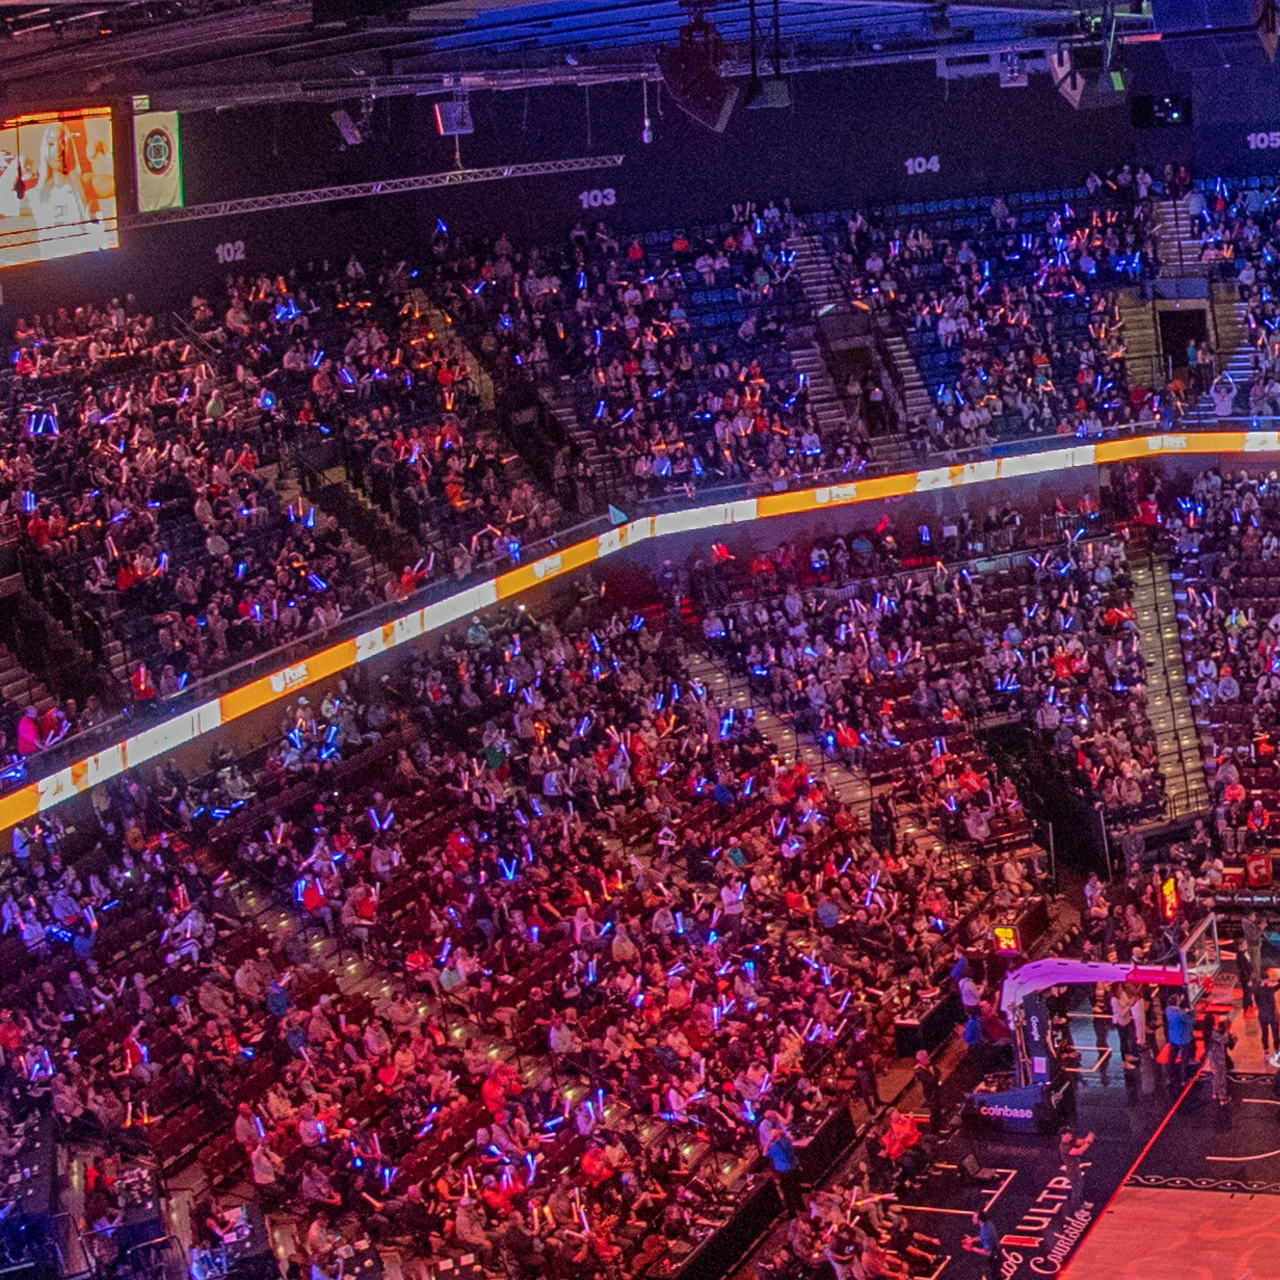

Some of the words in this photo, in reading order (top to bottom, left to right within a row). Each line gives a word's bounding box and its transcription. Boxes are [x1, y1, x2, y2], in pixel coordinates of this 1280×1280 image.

[1246, 131, 1280, 150] 105
[904, 155, 939, 174] 104
[579, 188, 616, 209] 103
[215, 240, 246, 264] 102
[980, 1105, 1033, 1119] coinbase
